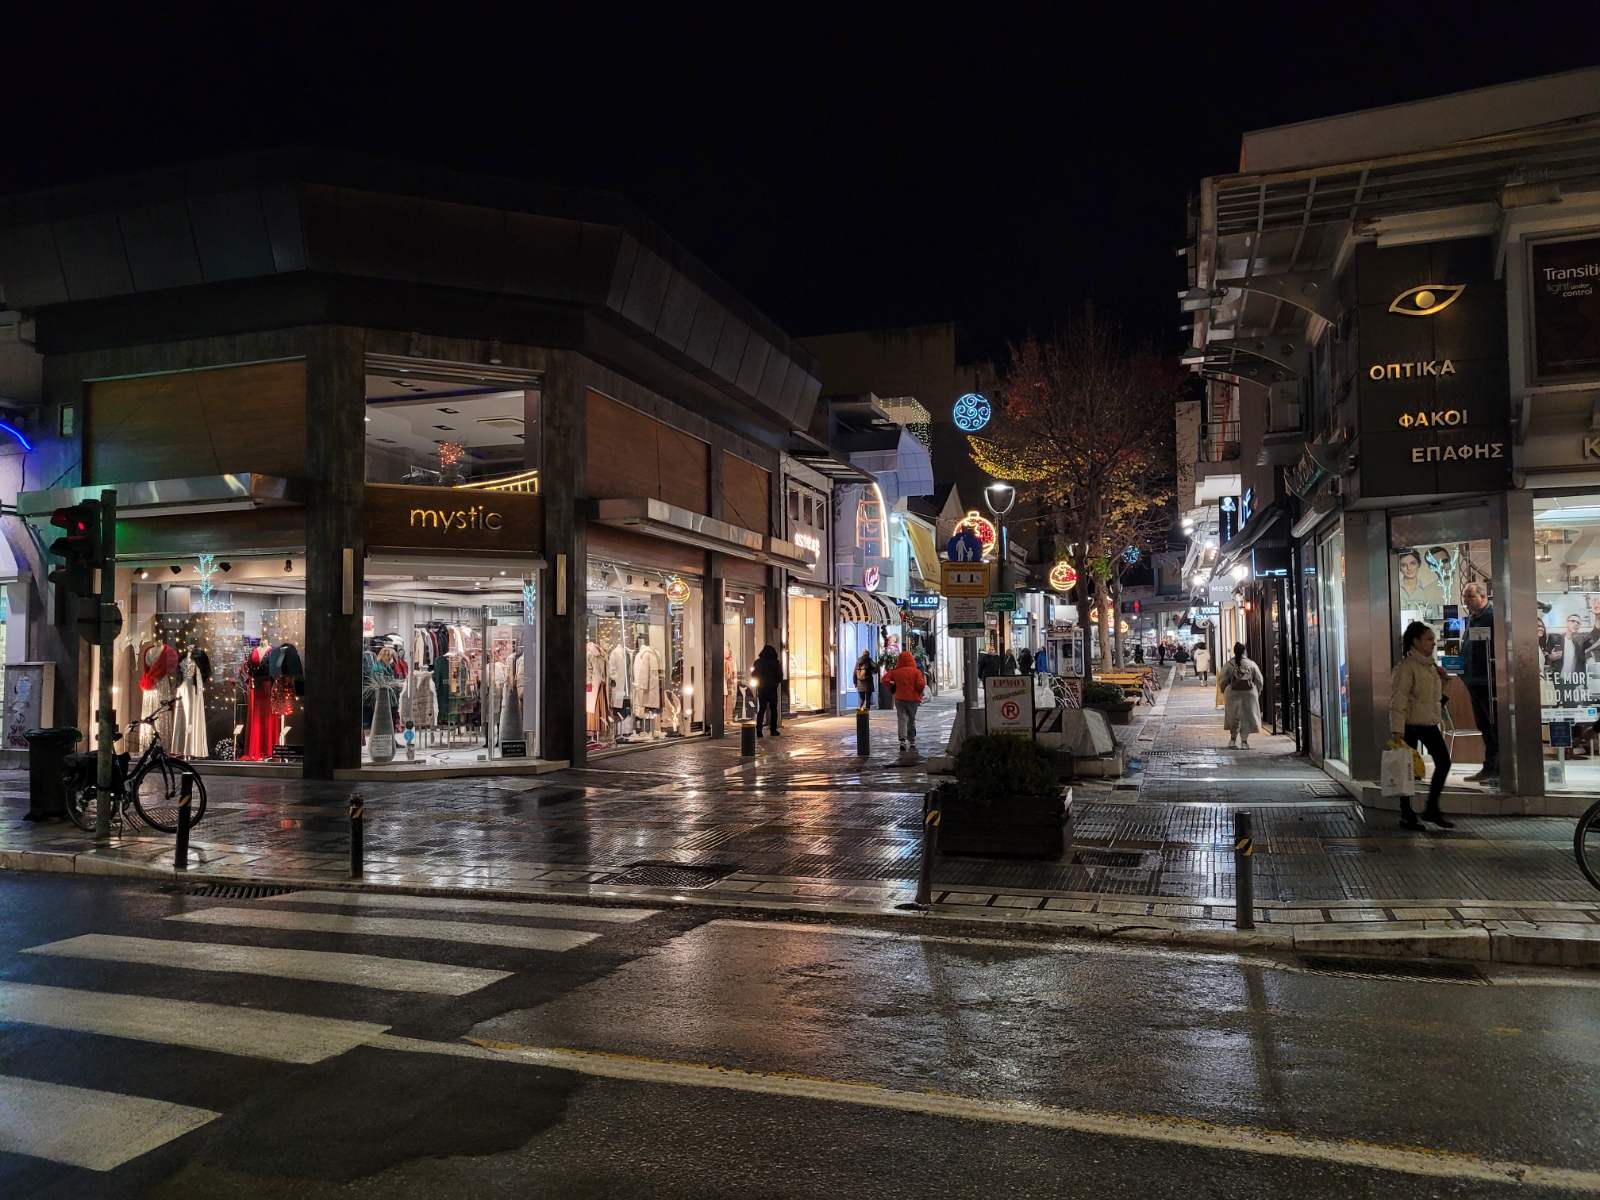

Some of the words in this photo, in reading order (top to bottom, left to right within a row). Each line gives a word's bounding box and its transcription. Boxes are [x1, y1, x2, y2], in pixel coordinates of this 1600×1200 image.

[1562, 288, 1593, 297] control
[1370, 359, 1456, 380] ΟΠΤΙΚΑ
[1398, 409, 1468, 428] ΦΑΚΟΙ
[1411, 443, 1504, 463] ΕΠΑΦΗΣ
[410, 505, 503, 534] mystic
[1563, 671, 1593, 685] MORE
[1563, 688, 1598, 702] MORE.
